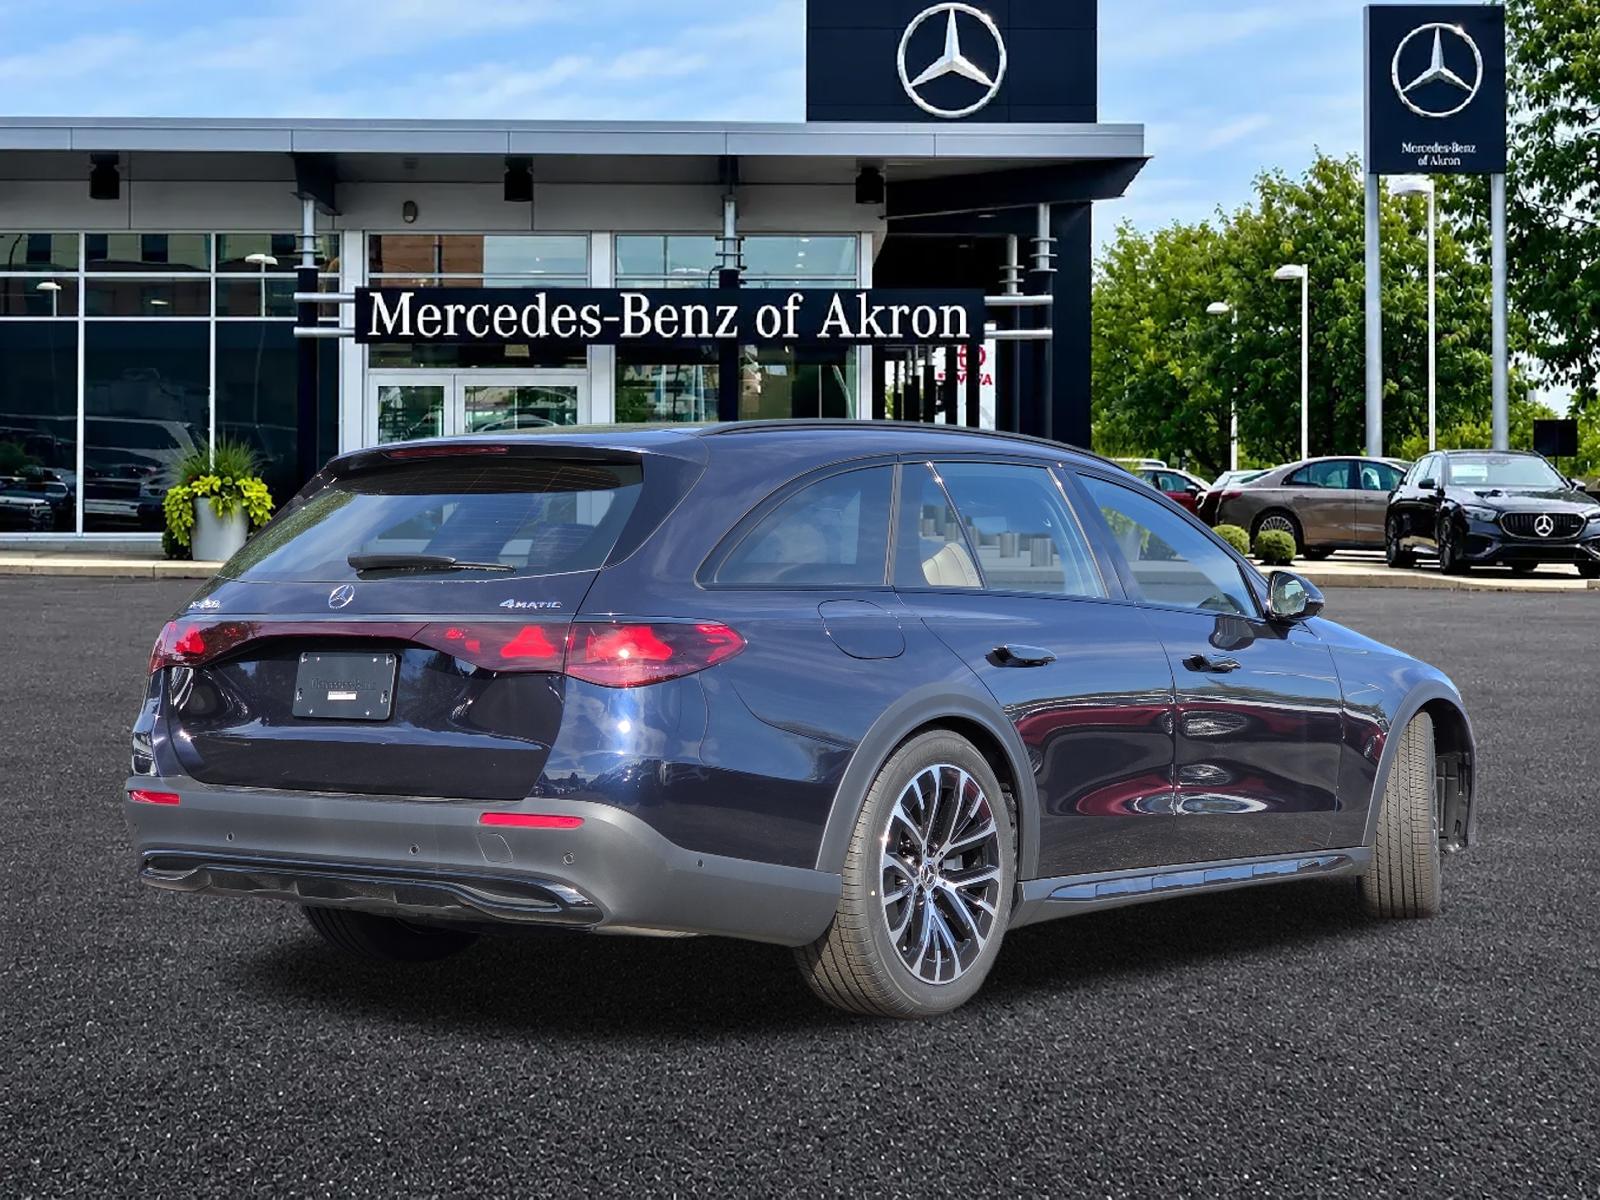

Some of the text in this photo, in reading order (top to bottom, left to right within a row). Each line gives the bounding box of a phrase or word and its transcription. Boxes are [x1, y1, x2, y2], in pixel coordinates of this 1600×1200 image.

[1401, 142, 1477, 154] Mercedes-Benz
[1417, 154, 1461, 166] of Akron
[367, 291, 970, 338] Mercedes-Benz of Akron
[499, 598, 562, 609] 4MATIC
